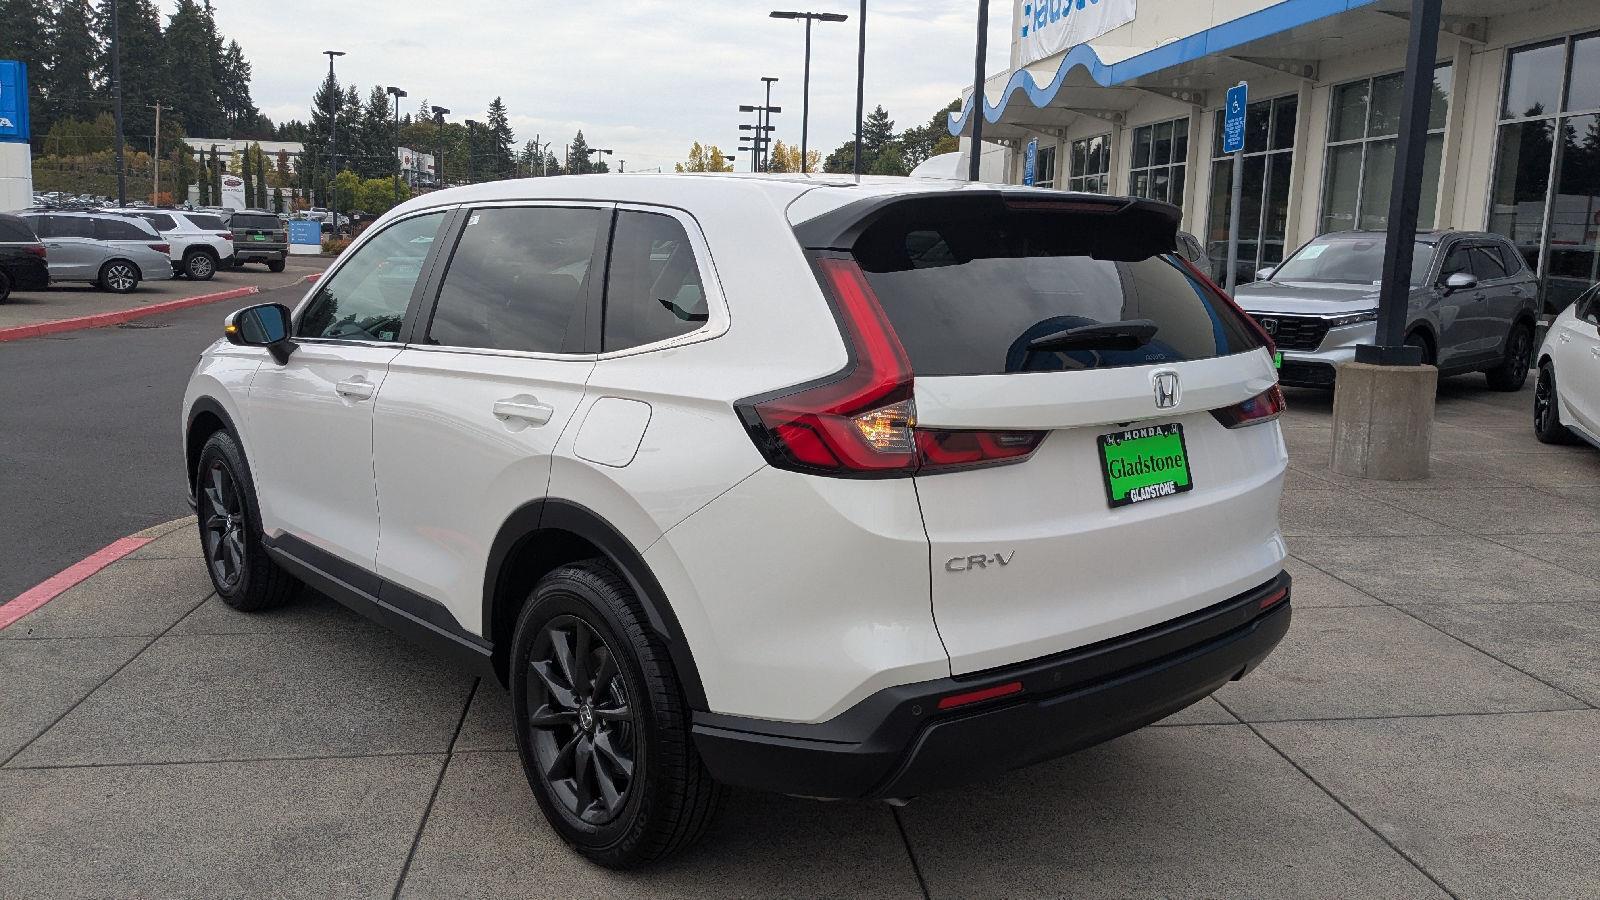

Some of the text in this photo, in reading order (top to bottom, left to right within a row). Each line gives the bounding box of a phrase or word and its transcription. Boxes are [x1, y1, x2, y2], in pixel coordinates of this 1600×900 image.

[1125, 426, 1163, 440] HONDA
[1109, 454, 1183, 479] Gladstone
[1130, 481, 1176, 502] GLADSTONE
[945, 550, 1015, 571] CR-V
